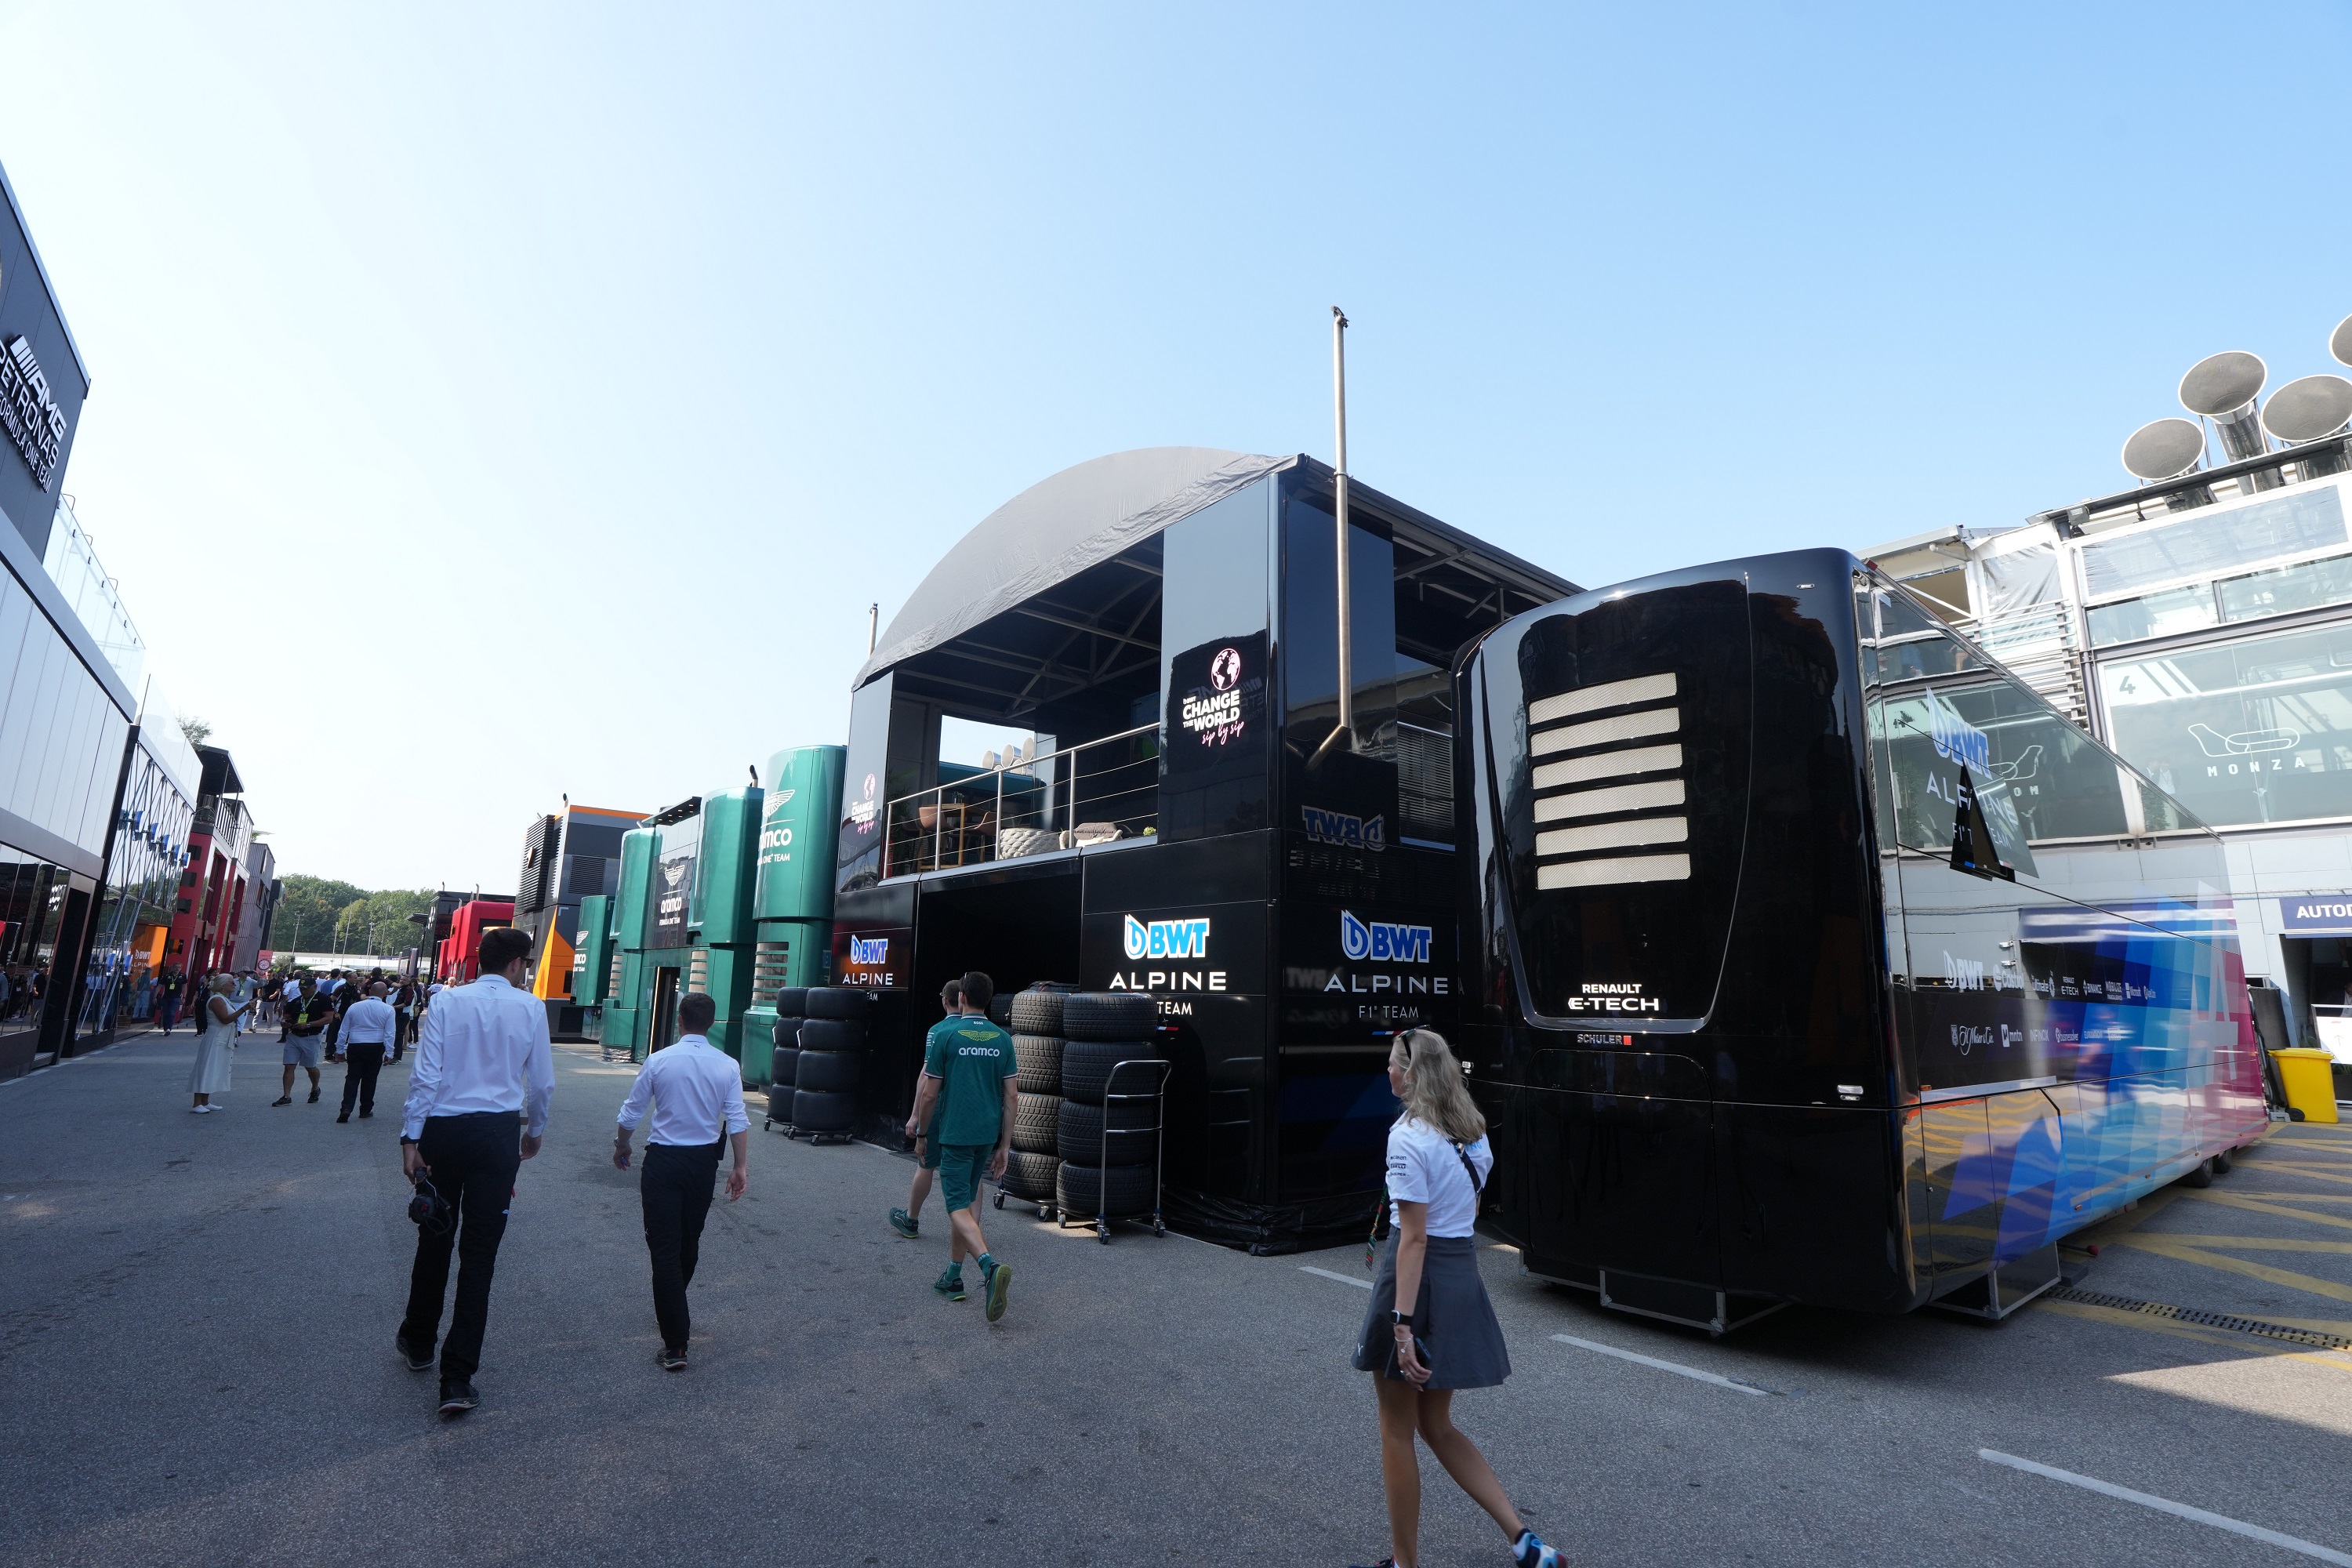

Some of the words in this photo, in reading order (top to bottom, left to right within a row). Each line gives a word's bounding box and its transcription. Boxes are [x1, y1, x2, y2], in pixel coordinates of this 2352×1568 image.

[27, 368, 67, 443] AMG
[0, 395, 26, 452] ORMULA
[25, 441, 39, 470] ONE
[37, 459, 53, 494] TEAM
[2119, 675, 2136, 695] 4
[1182, 689, 1240, 720] CHANGE
[1182, 719, 1194, 728] THE
[1193, 706, 1240, 731] WORLD
[1202, 730, 1215, 747] sip
[1218, 717, 1229, 746] by
[1230, 720, 1245, 738] sip
[1947, 710, 1993, 780] BWT
[2207, 757, 2306, 778] MONZA
[851, 800, 874, 816] CHANGE
[855, 811, 873, 824] WORLD
[758, 828, 793, 851] amco
[773, 853, 790, 862] TEAM
[661, 896, 682, 914] aramco
[1147, 917, 1210, 959] BWT
[1370, 921, 1432, 964] BWT
[860, 938, 889, 964] BWT
[842, 972, 894, 985] ALPINE
[1109, 971, 1227, 990] ALPINE
[1956, 958, 1984, 991] BWT
[1323, 973, 1449, 995] ALPINE
[1581, 983, 1642, 994] RENAULT
[2061, 985, 2079, 996] E-TECH
[2087, 982, 2103, 994] BINANCE
[866, 992, 878, 1001] AM
[1567, 997, 1660, 1011] E-TECH
[1156, 1001, 1192, 1015] TEAM
[1382, 1006, 1419, 1018] TEAM
[1577, 1033, 1623, 1046] SCHULER
[2029, 1029, 2049, 1042] INFINOX
[958, 1047, 1000, 1058] aramco
